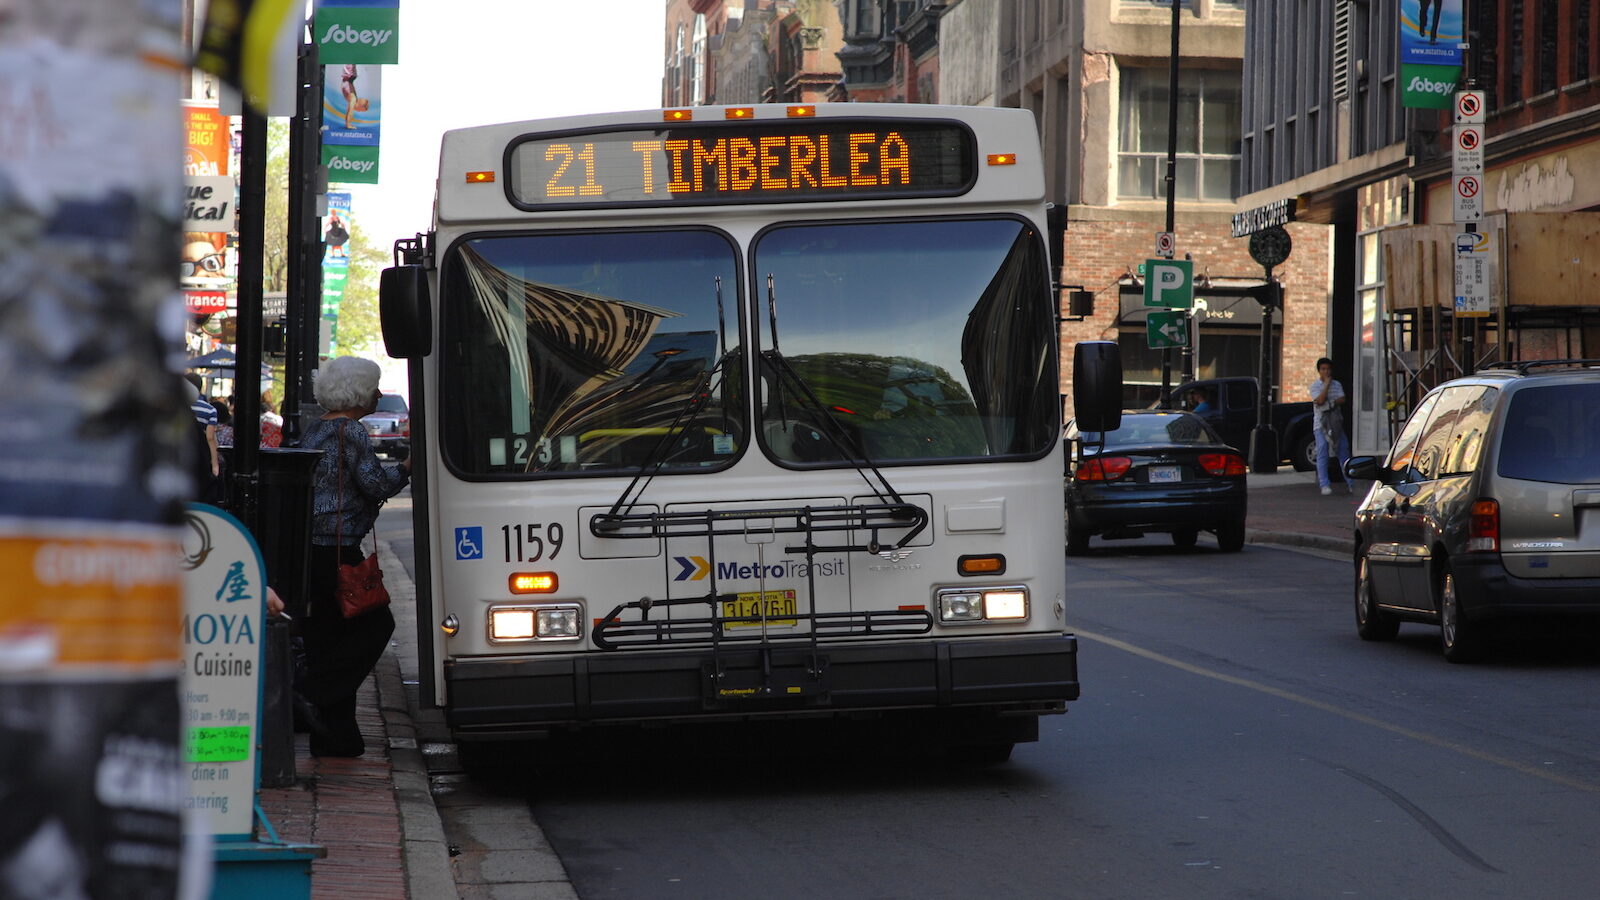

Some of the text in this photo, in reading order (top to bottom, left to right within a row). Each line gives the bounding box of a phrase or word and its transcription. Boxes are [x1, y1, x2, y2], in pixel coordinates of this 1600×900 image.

[321, 23, 392, 47] Sobeys
[1406, 76, 1456, 96] Sobeys
[191, 112, 211, 121] SMALL
[189, 131, 214, 146] BIG!
[327, 156, 375, 173] Sobeys
[545, 131, 910, 197] 21 TIMBERLEA
[501, 522, 564, 563] 1159
[215, 560, 252, 603] 屋
[194, 651, 252, 677] Cuisine
[186, 691, 209, 703] Hours
[192, 762, 229, 781] dine in
